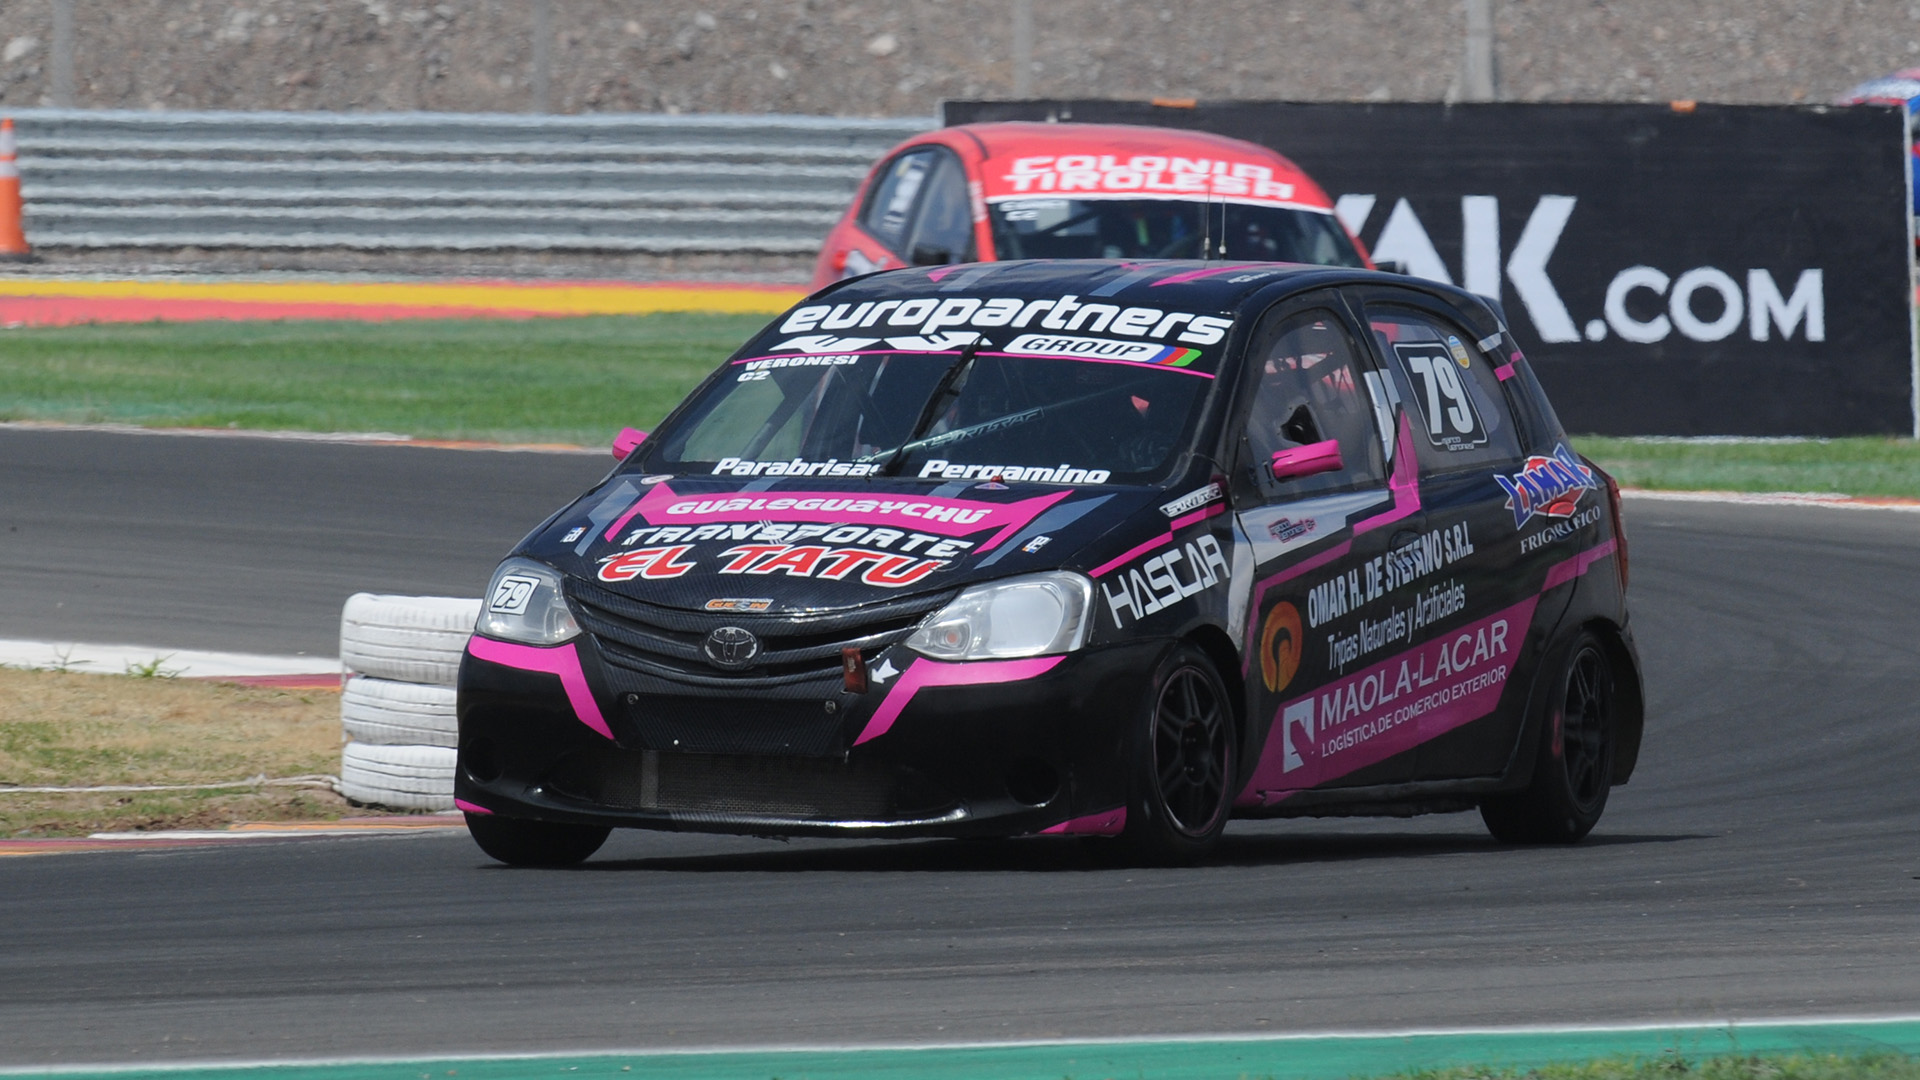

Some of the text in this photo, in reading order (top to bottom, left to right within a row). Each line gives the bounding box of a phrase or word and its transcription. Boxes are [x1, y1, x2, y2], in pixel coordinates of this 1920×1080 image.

[779, 295, 1235, 346] europartners
[745, 355, 860, 371] VERONESI
[1022, 337, 1148, 357] GROUP
[737, 370, 771, 382] C2
[1408, 356, 1474, 434] 79
[918, 459, 1111, 484] Pergamino
[623, 523, 975, 557] TRANSPORTE
[596, 543, 952, 588] EL TATU
[1101, 532, 1231, 629] HASCAR
[1308, 575, 1348, 629] OMAR
[1348, 568, 1364, 611] H.
[1365, 556, 1384, 602] DE
[1385, 529, 1443, 592] STEFANO
[492, 579, 532, 609] 79
[1327, 578, 1466, 676] Tripas Naturales y Artificiales
[1320, 619, 1509, 731] MAOLA-LACAR
[1377, 713, 1393, 731] DE
[1394, 688, 1450, 724] COMERCIO
[1451, 665, 1507, 701] EXTERIOR
